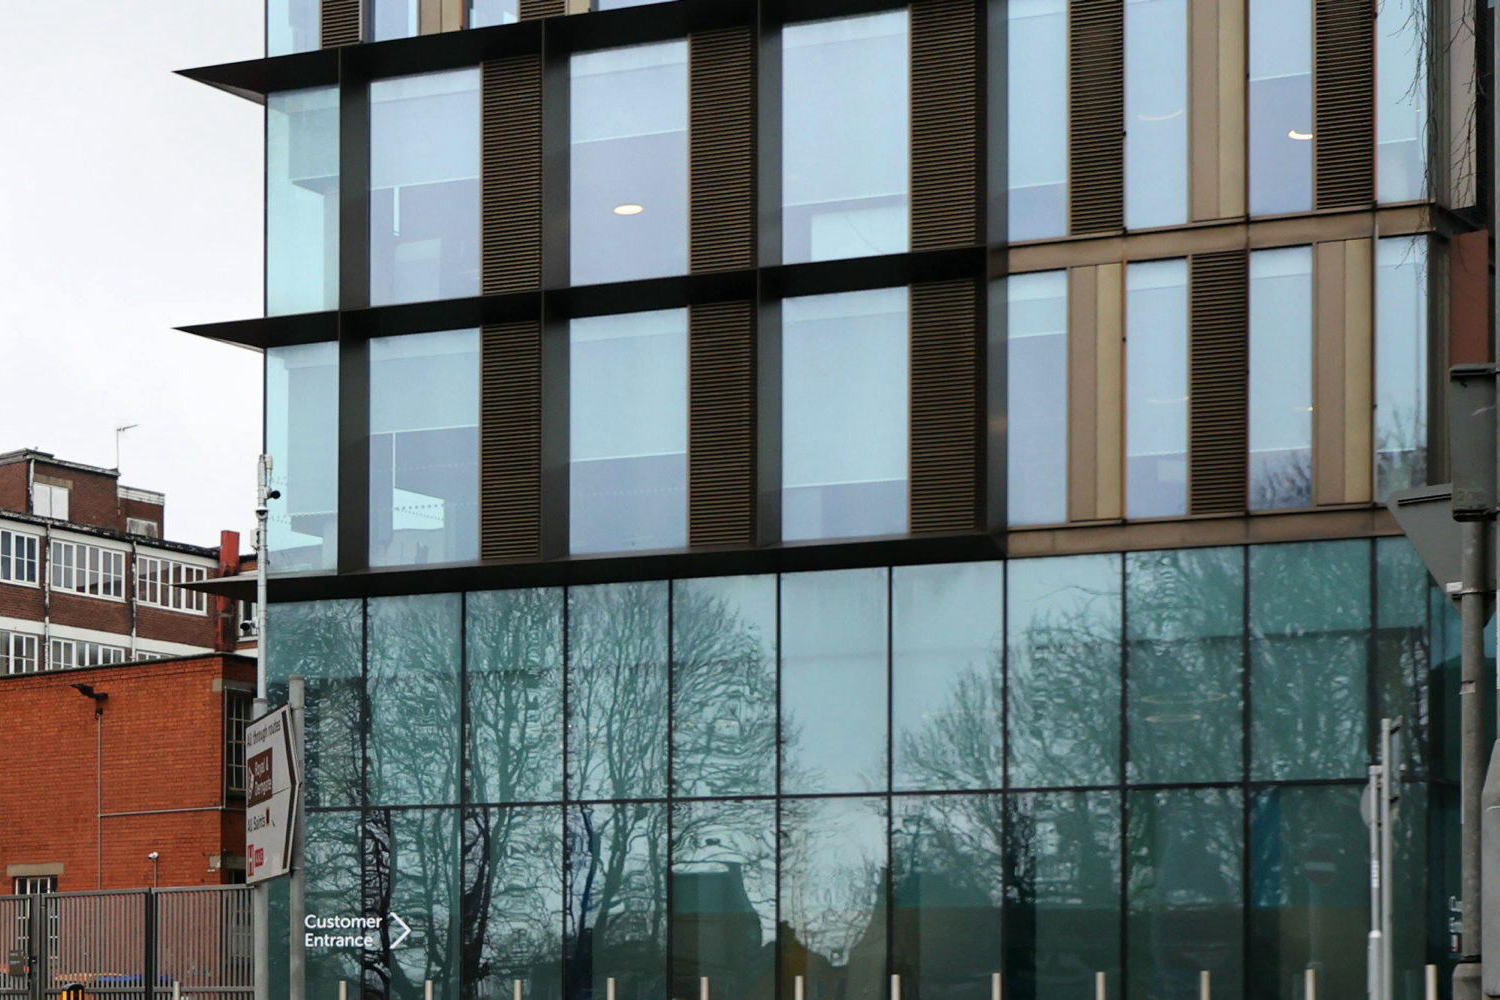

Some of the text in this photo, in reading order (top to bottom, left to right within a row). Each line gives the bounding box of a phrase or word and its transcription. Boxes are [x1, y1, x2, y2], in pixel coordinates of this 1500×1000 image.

[253, 725, 267, 745] through
[268, 719, 281, 736] routes
[254, 758, 265, 778] Royal
[304, 914, 383, 929] Customer
[304, 932, 374, 948] Entrance
